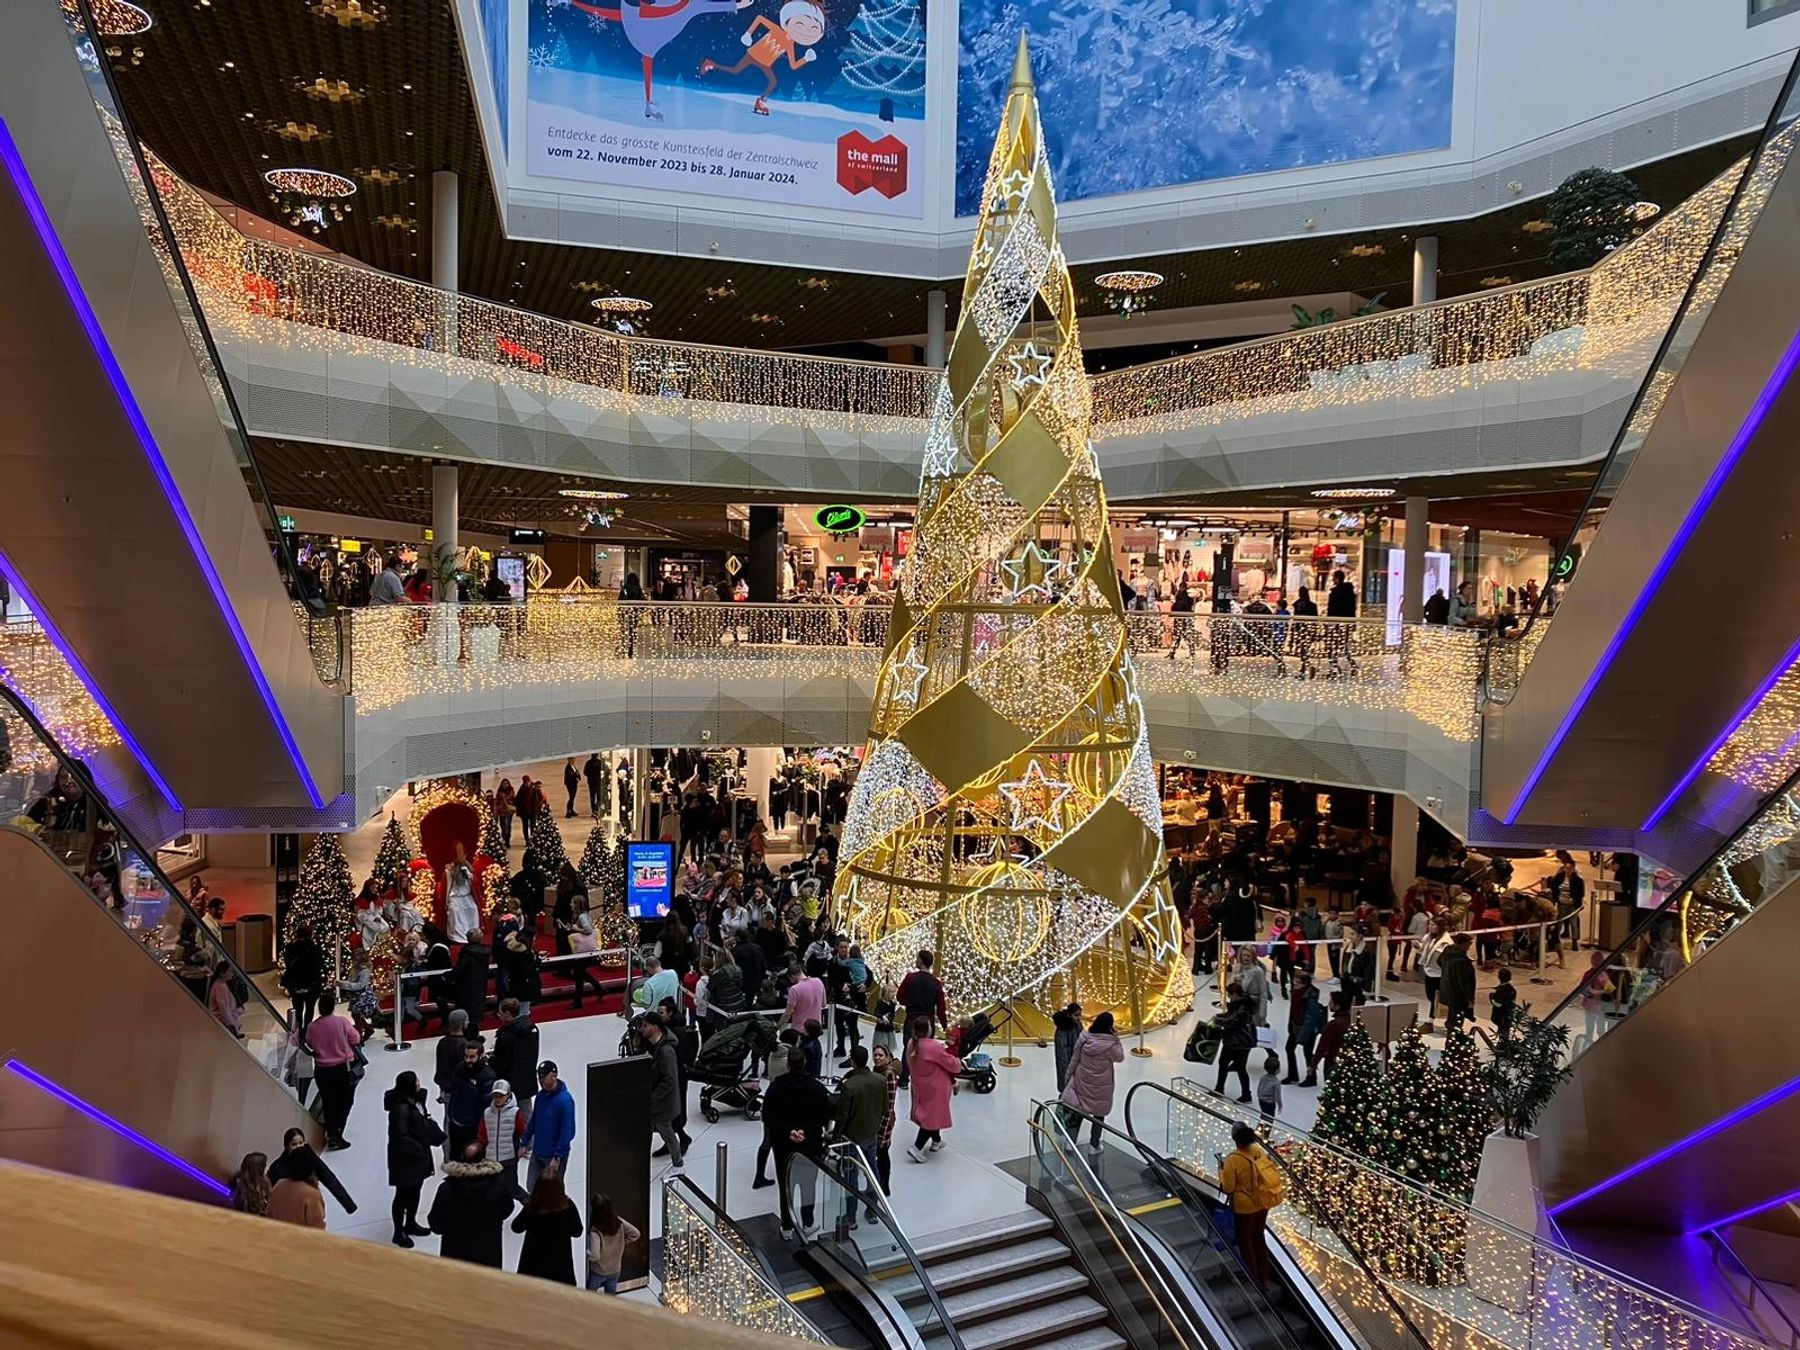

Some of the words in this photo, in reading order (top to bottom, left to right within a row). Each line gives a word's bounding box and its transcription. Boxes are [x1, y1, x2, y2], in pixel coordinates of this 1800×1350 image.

[547, 126, 597, 143] Entdecke
[600, 133, 618, 146] das
[663, 141, 724, 158] Kunsteisfeld
[727, 149, 744, 161] der
[746, 150, 819, 170] Zentralschweiz
[847, 149, 869, 161] the
[871, 153, 898, 165] mall
[547, 147, 573, 158] vom
[576, 149, 594, 161] 22.
[597, 151, 658, 168] November
[660, 158, 688, 171] 2023
[690, 162, 707, 174] bis
[709, 164, 726, 177] 28.
[729, 167, 766, 180] Januar
[768, 172, 799, 185] 2024.
[857, 163, 898, 173] switzerland
